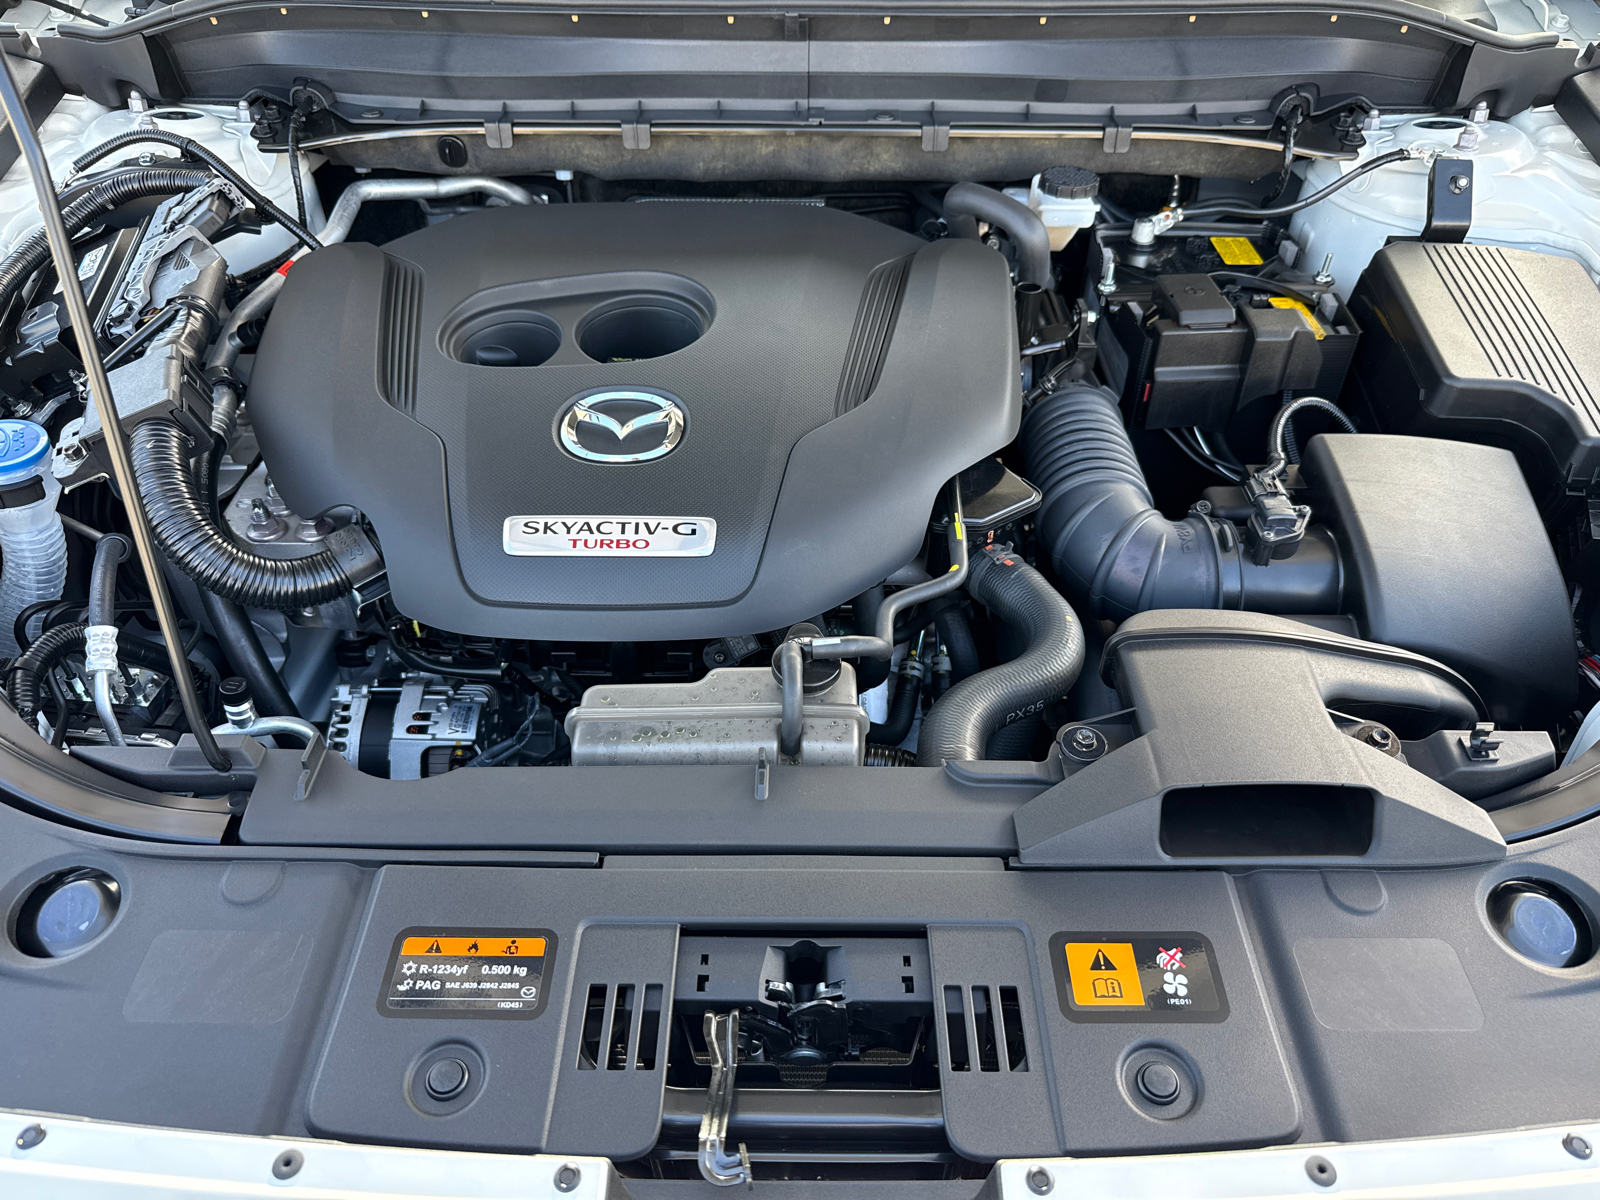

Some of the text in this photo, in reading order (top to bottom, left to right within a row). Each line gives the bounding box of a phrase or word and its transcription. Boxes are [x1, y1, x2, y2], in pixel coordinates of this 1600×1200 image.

[522, 521, 697, 536] SKYACTIV-G
[568, 538, 650, 550] TURBO
[1005, 700, 1044, 725] PX35
[419, 964, 528, 977] R-1234yf 0.500 kg
[415, 980, 442, 990] PAG
